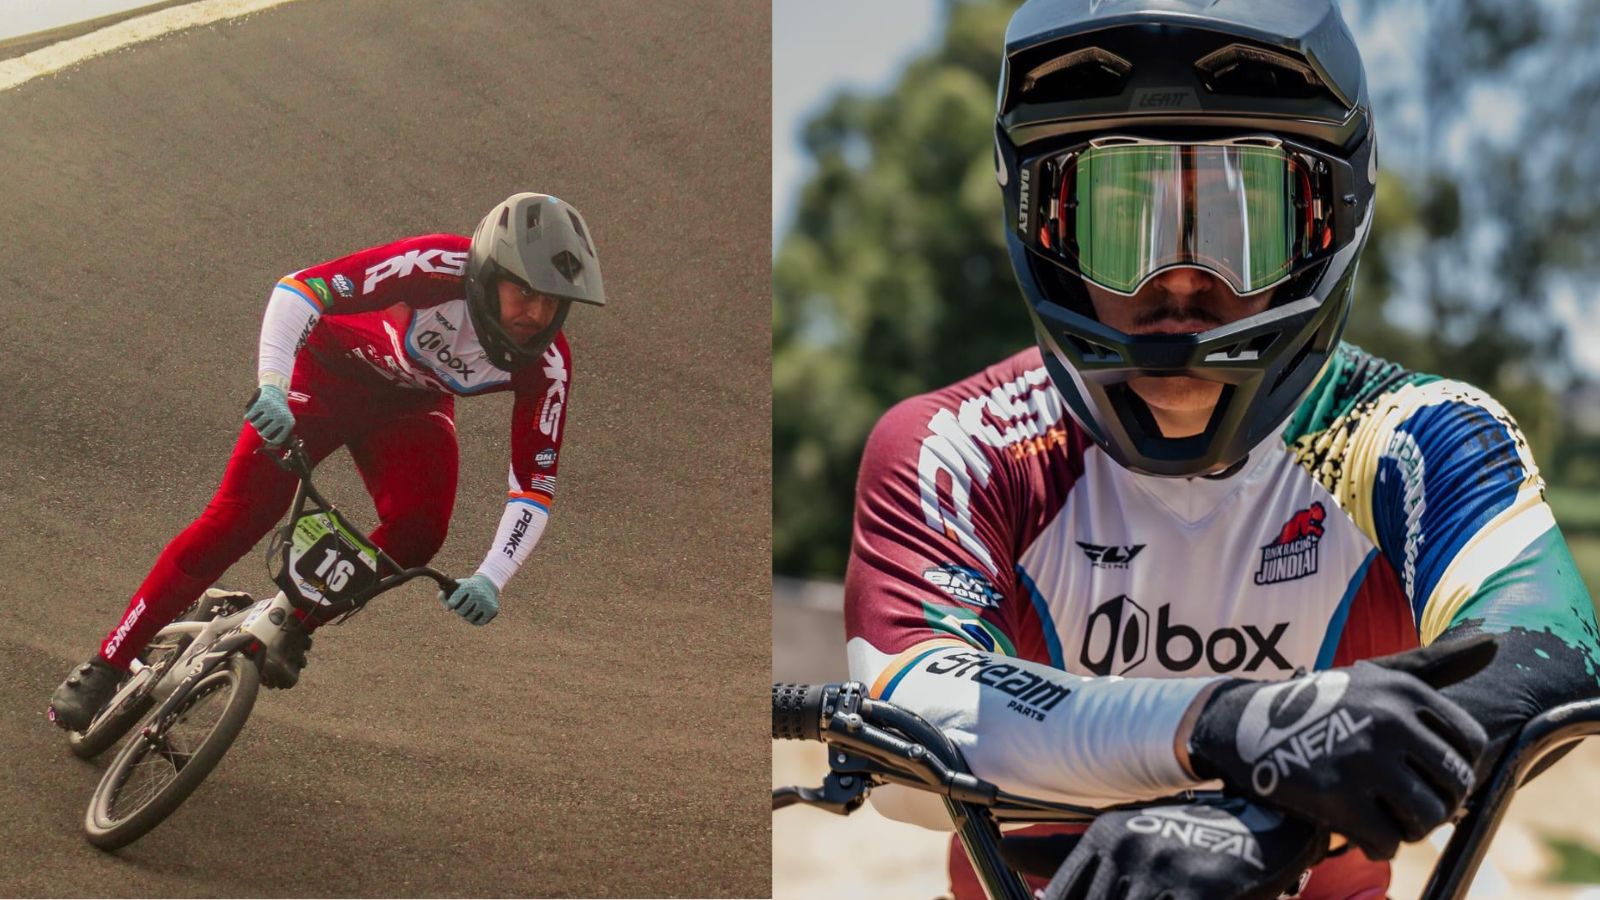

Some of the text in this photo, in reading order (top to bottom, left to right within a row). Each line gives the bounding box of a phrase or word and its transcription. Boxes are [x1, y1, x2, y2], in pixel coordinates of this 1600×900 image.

[1018, 168, 1030, 235] OAKLEY
[362, 249, 469, 295] PKS
[437, 344, 475, 381] box
[503, 508, 534, 560] PENKS
[1074, 541, 1146, 563] FLY
[315, 548, 355, 592] 16
[105, 597, 146, 659] PENKS
[1156, 603, 1294, 674] box
[1007, 700, 1047, 722] PARTS
